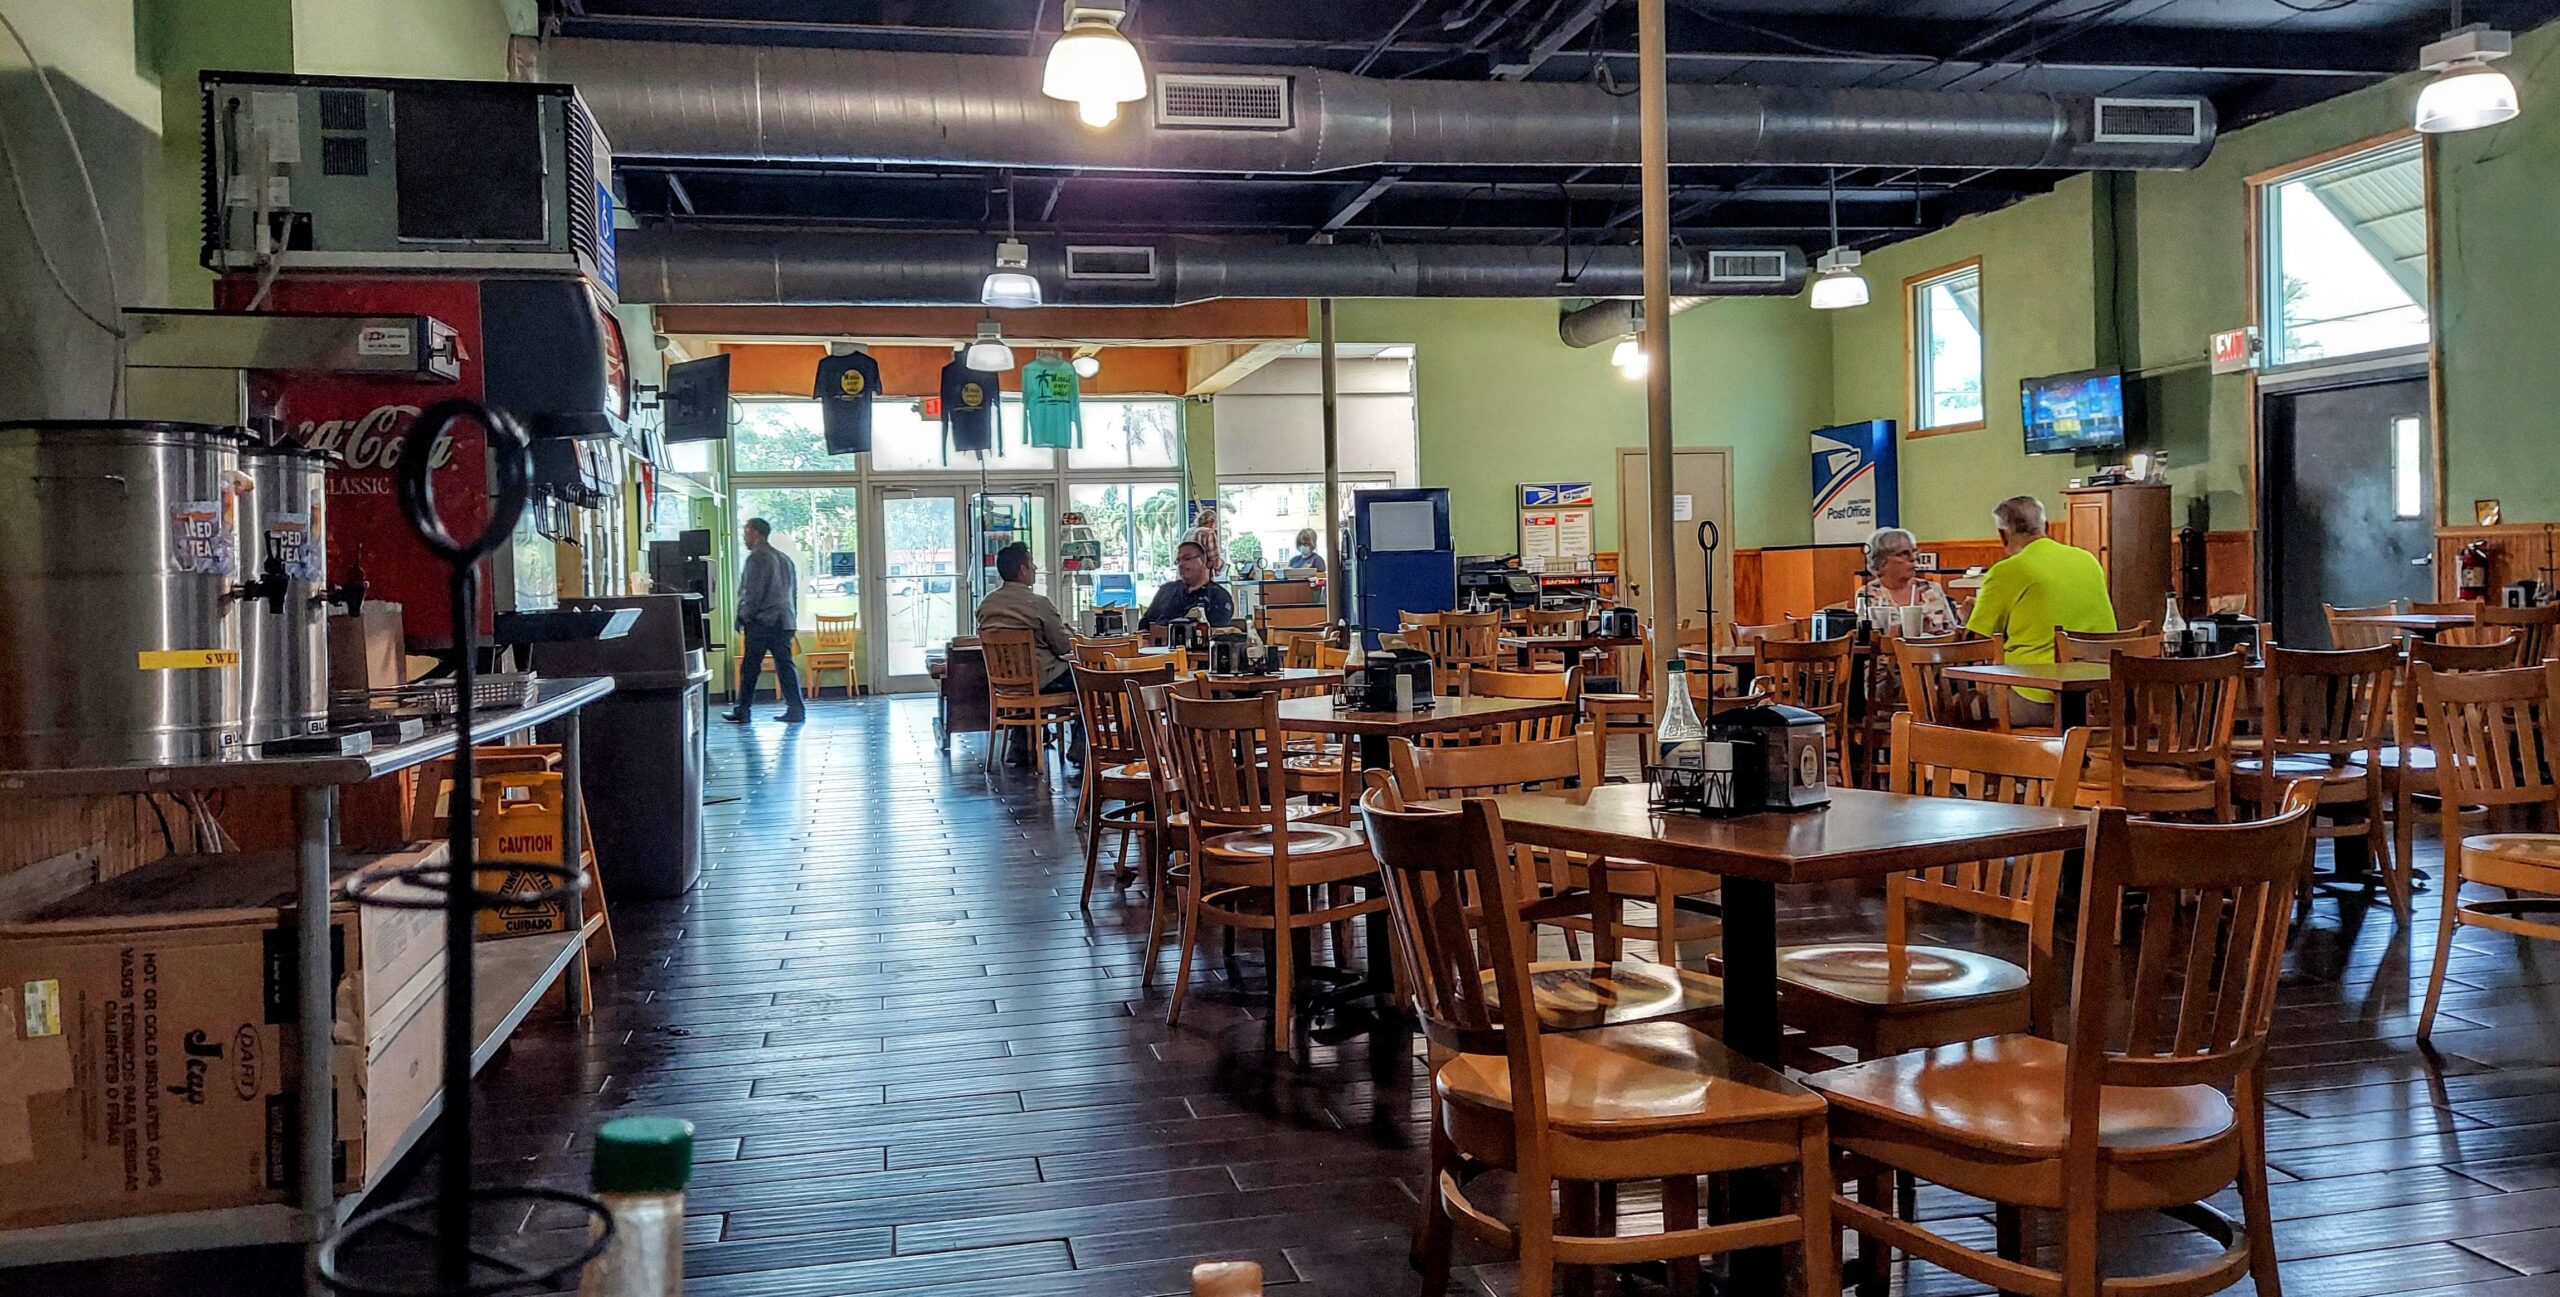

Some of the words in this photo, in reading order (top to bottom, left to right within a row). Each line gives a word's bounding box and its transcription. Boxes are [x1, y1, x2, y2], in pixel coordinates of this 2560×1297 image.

[2216, 331, 2244, 361] EXIT
[326, 476, 390, 495] LASSIC
[1827, 507, 1846, 520] Post
[1846, 505, 1871, 518] Office
[185, 521, 212, 538] ICED
[280, 530, 301, 546] CED
[189, 540, 213, 557] TEA
[499, 835, 553, 854] CAUTION
[505, 919, 553, 932] CUIDADO
[121, 948, 134, 998] VASOS
[144, 953, 158, 984] HOT
[144, 989, 158, 1011] OR
[145, 1014, 159, 1057] COLD
[241, 1033, 255, 1088] DART
[107, 1088, 119, 1099] O
